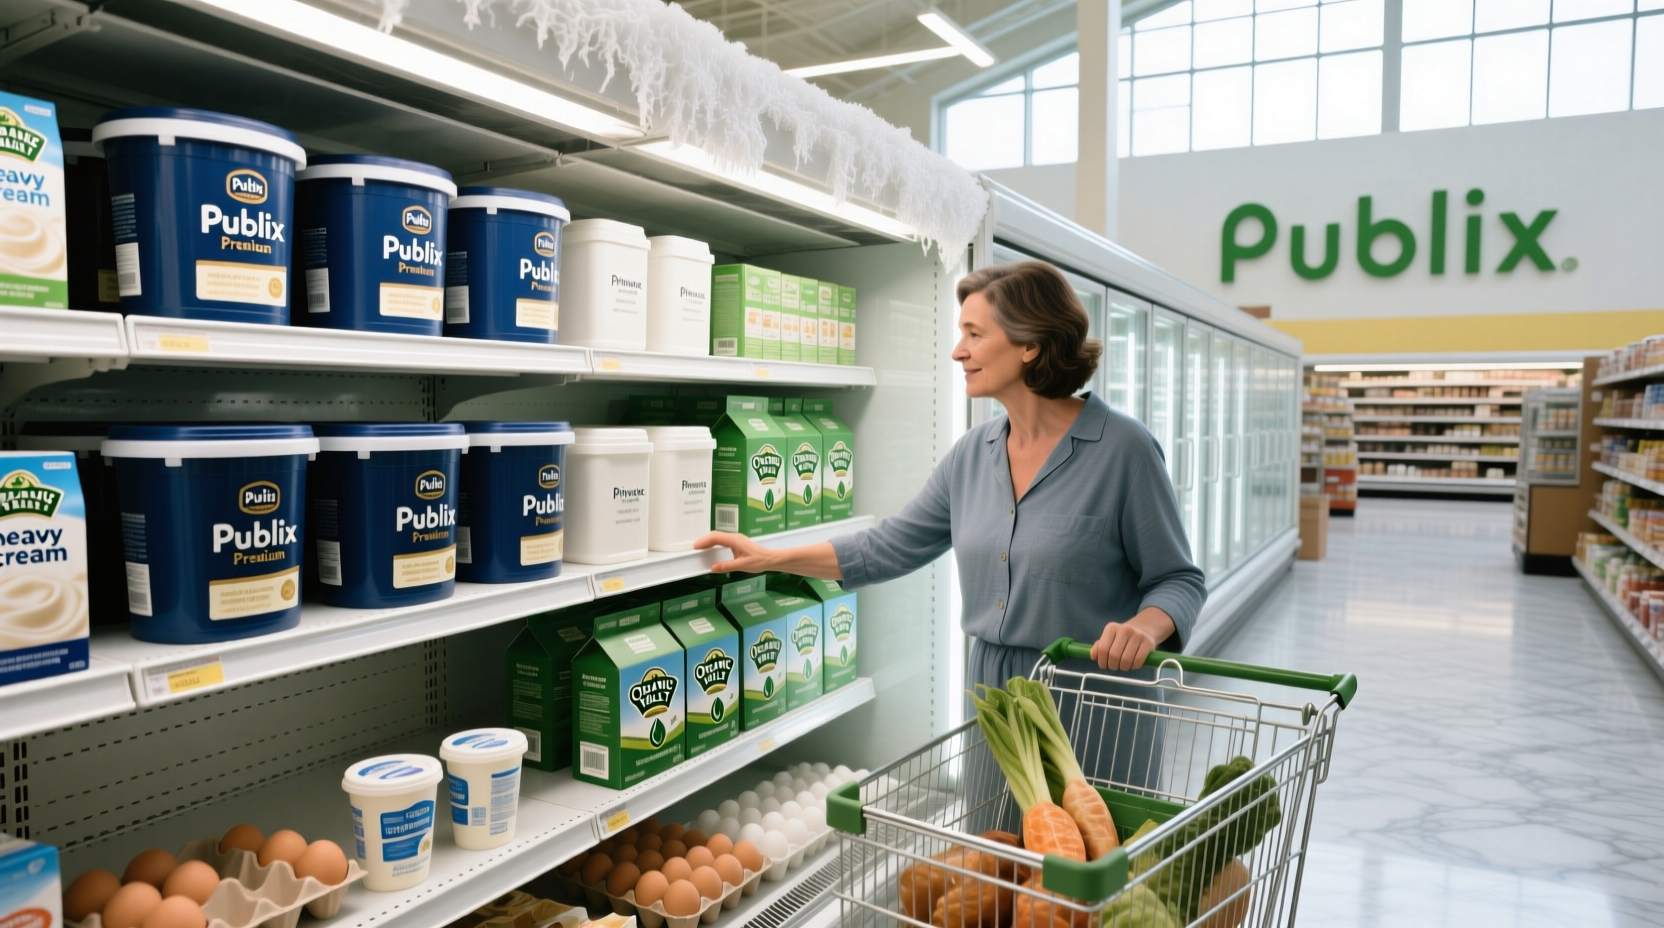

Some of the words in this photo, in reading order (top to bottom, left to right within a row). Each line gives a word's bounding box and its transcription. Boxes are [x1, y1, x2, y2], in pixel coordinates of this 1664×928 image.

[0, 169, 45, 191] eavy
[0, 187, 50, 207] eam
[201, 204, 285, 242] Publix
[1220, 188, 1558, 284] Publix
[383, 235, 443, 266] Publix
[396, 503, 456, 531] Publix
[213, 518, 297, 553] Publix
[0, 547, 68, 567] ream
